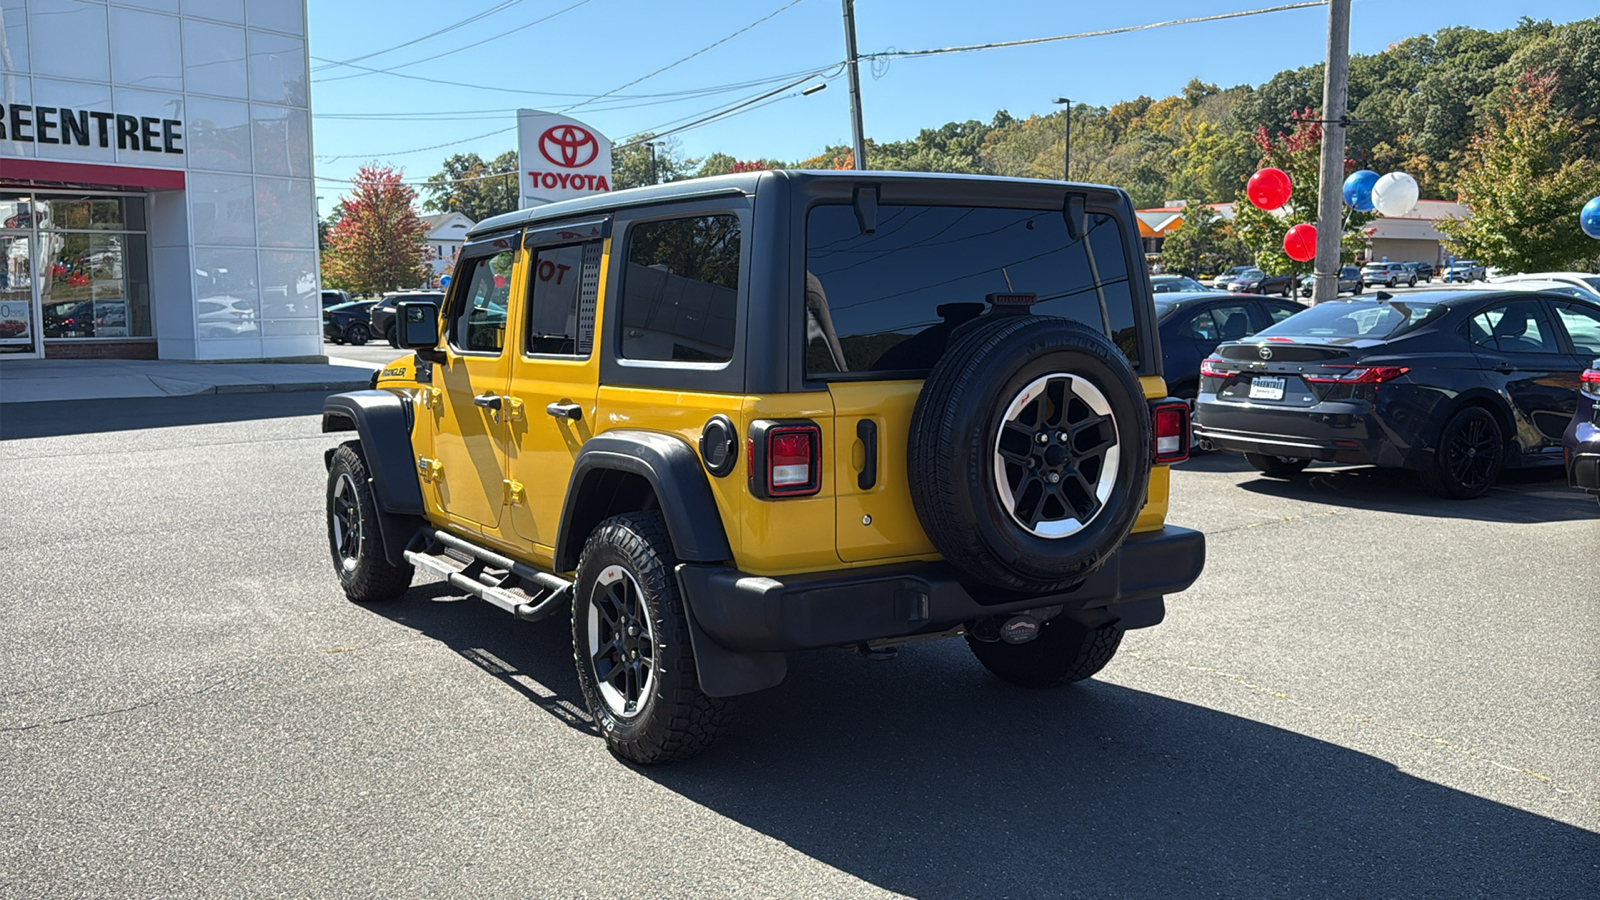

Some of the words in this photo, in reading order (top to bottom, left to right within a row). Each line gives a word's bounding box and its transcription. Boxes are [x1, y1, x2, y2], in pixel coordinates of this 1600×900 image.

[0, 103, 184, 154] EENTREE
[528, 171, 610, 191] TOYOTA
[1253, 380, 1283, 390] GREENTREE
